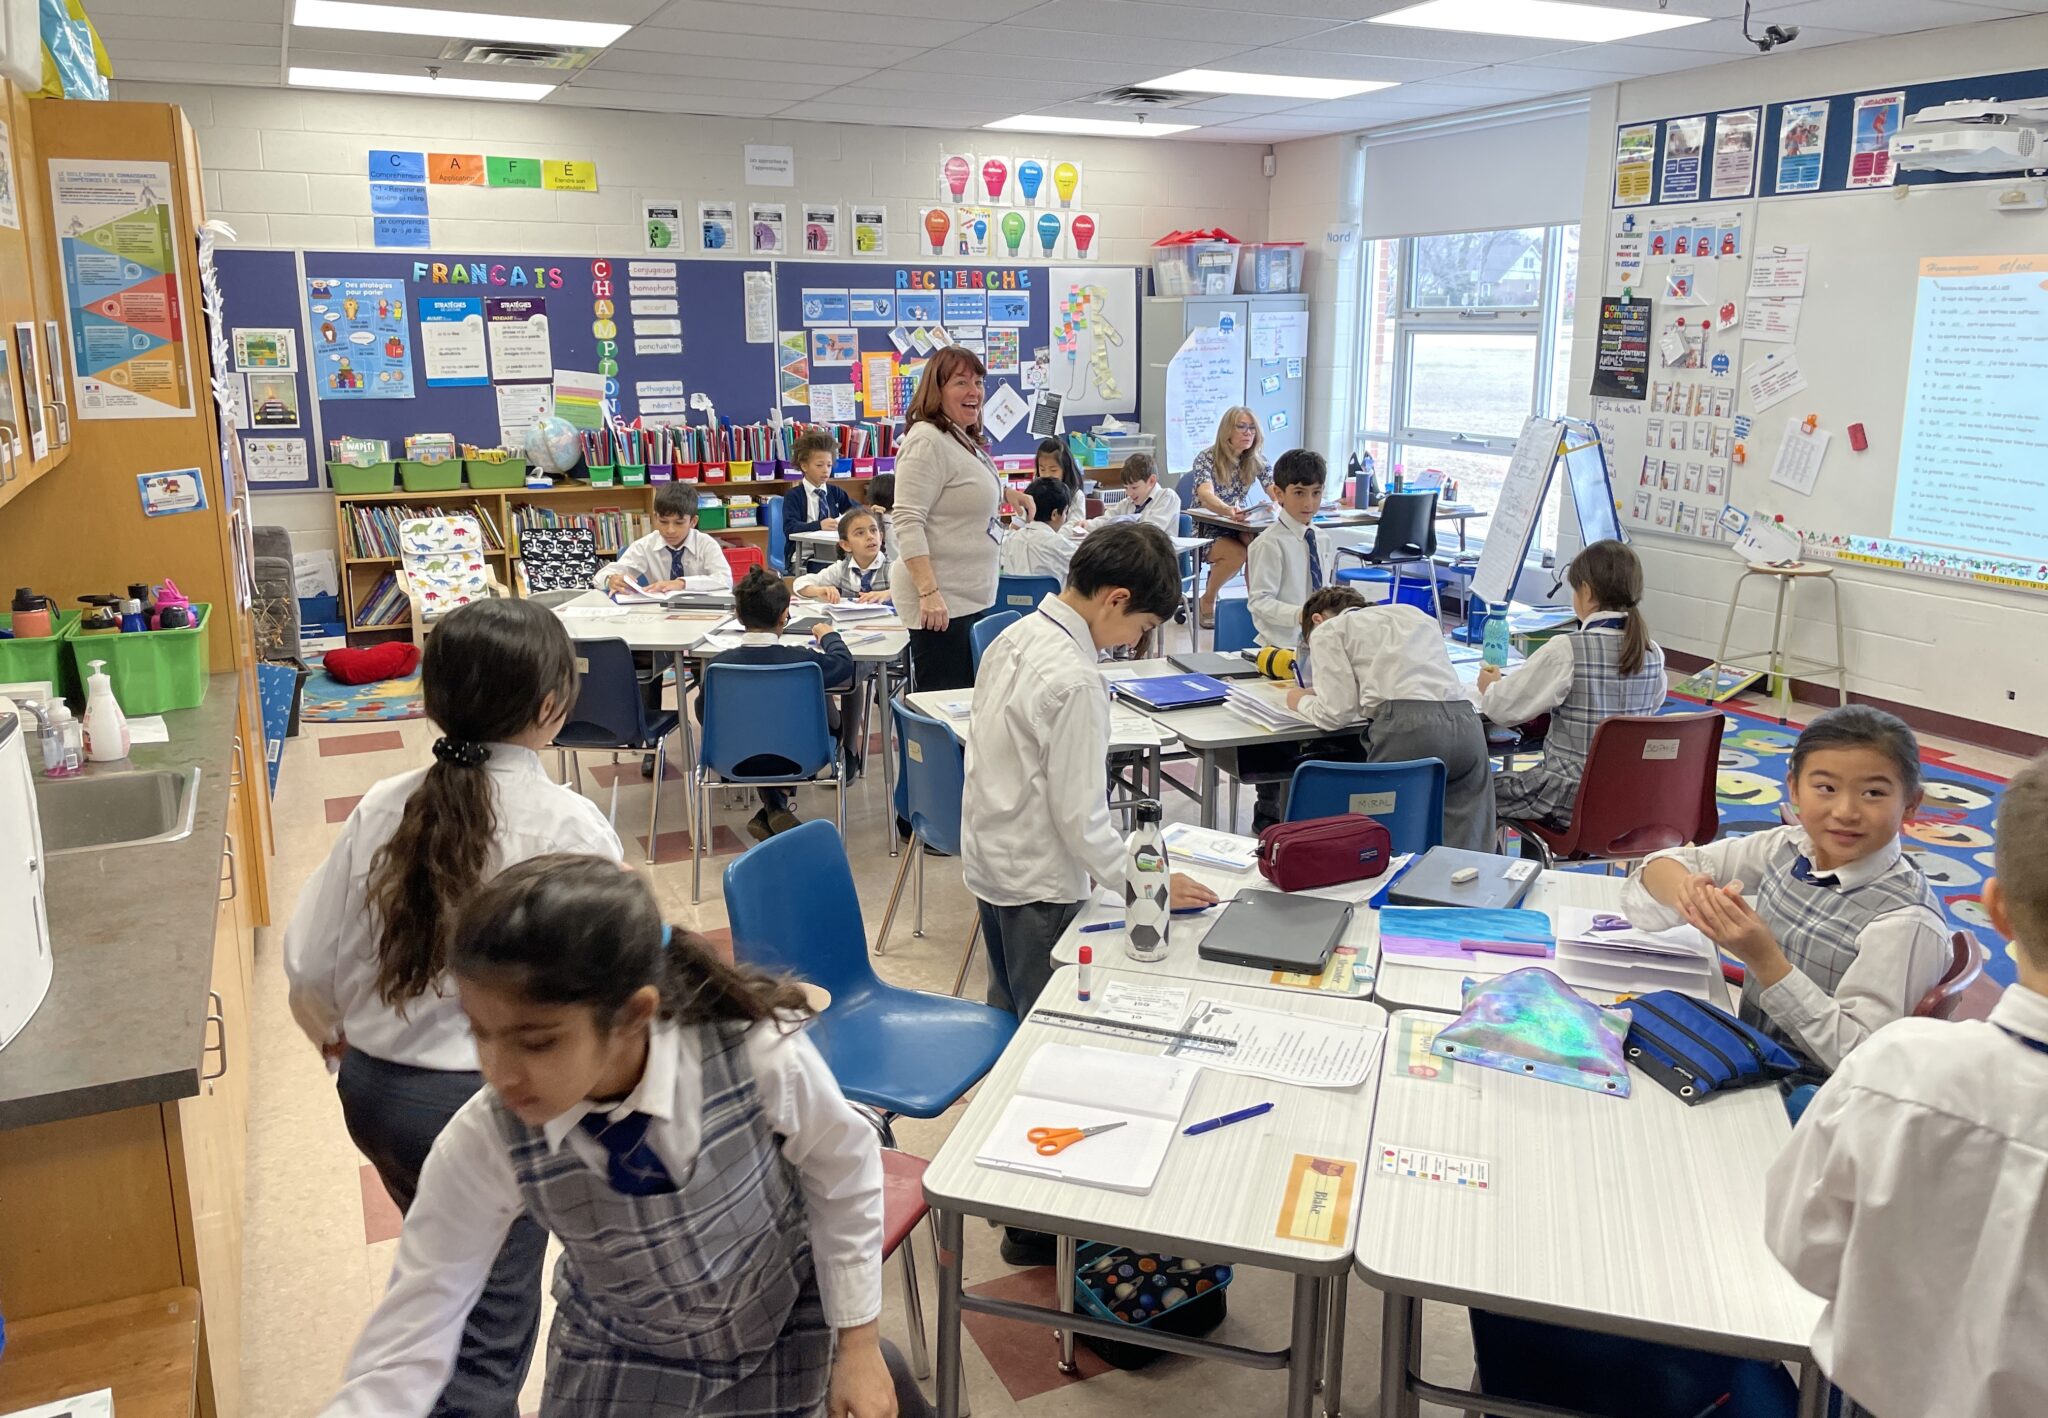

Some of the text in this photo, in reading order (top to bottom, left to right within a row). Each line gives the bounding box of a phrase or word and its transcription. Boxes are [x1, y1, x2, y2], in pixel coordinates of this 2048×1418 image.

[390, 154, 401, 167] C
[450, 157, 461, 169] A
[509, 160, 518, 173] F
[564, 162, 574, 176] É
[1327, 231, 1351, 243] Nord
[633, 266, 675, 275] conjugaison
[895, 269, 1032, 290] RECHERCHE
[633, 283, 675, 293] homophone
[434, 301, 467, 309] STRATÉGIES
[501, 300, 532, 308] STRATÉGIES
[638, 343, 681, 352] ponctuation
[640, 384, 681, 393] orthographe
[1310, 1191, 1328, 1215] Blake
